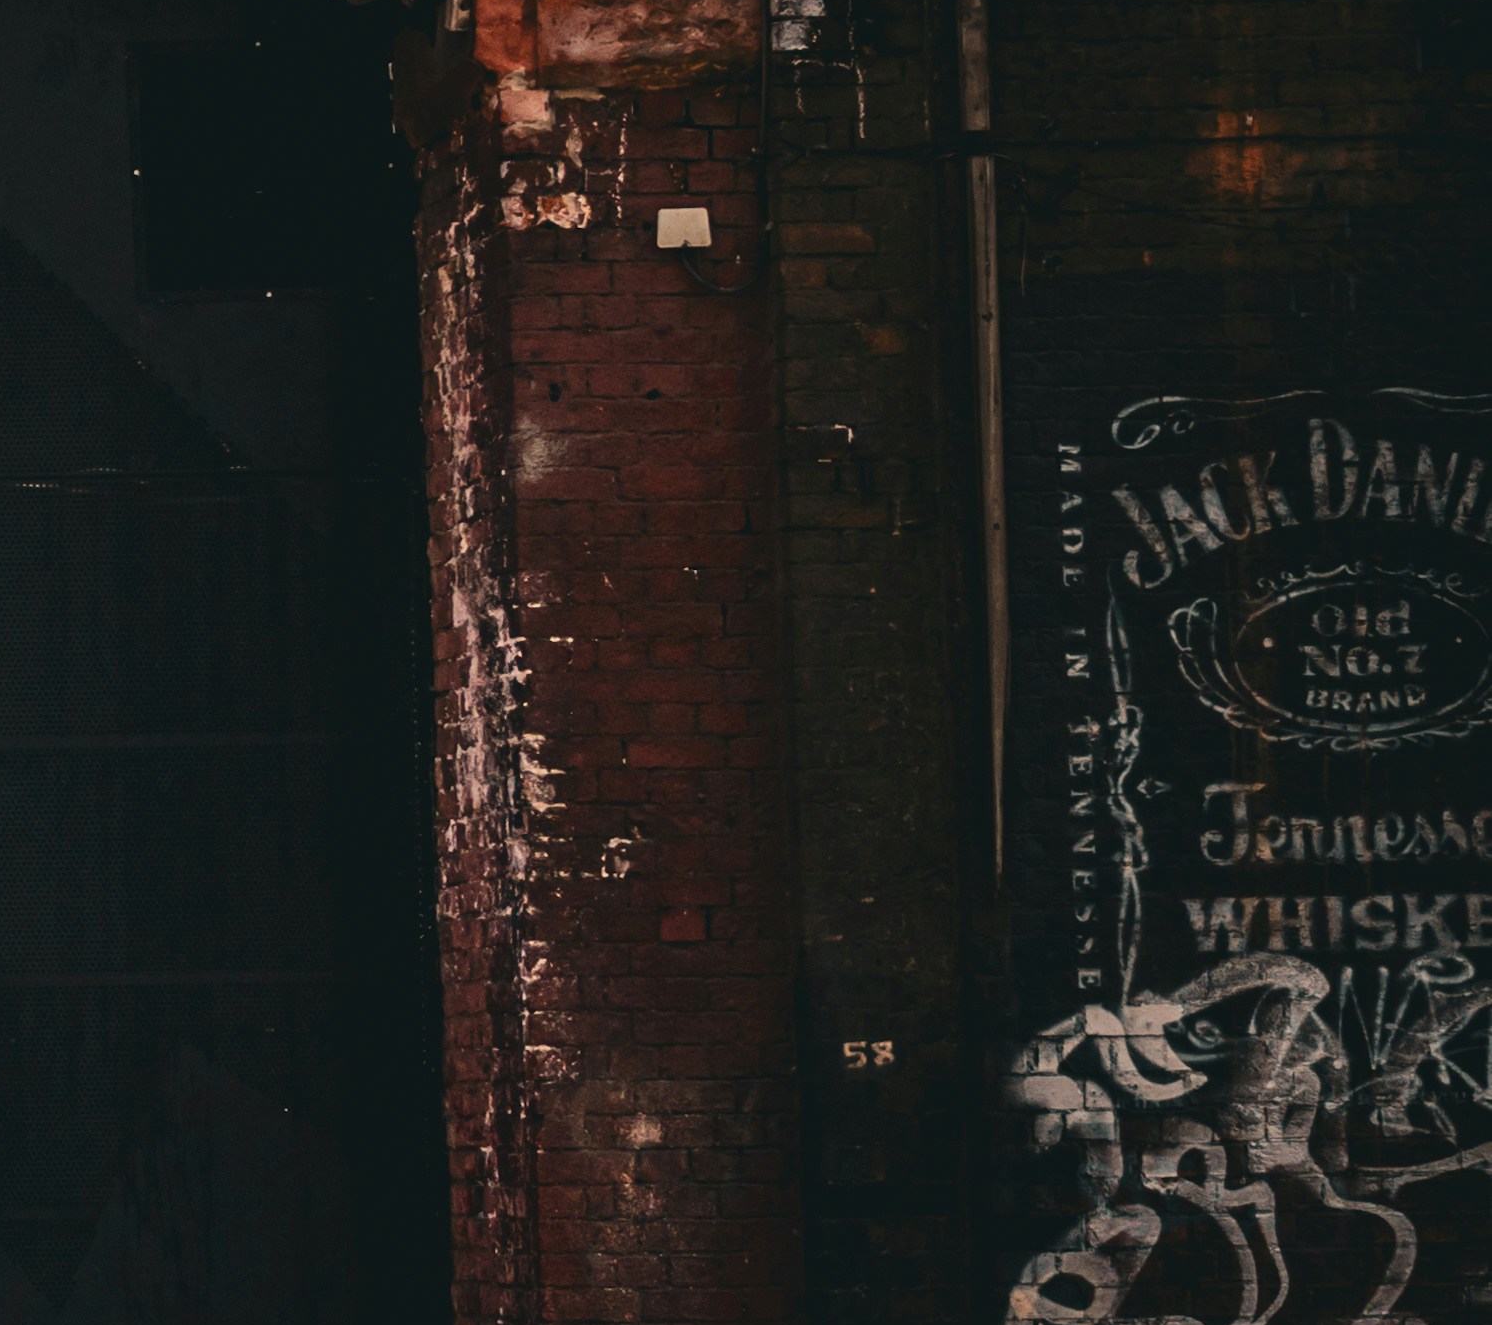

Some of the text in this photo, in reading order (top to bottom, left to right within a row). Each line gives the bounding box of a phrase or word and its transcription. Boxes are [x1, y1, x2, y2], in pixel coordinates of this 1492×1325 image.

[1057, 443, 1085, 588] MADE
[1111, 449, 1301, 590] JACK
[1310, 599, 1412, 639] Old
[1063, 627, 1091, 679] IN
[1305, 683, 1427, 714] BRAND
[842, 1040, 895, 1068] 58
